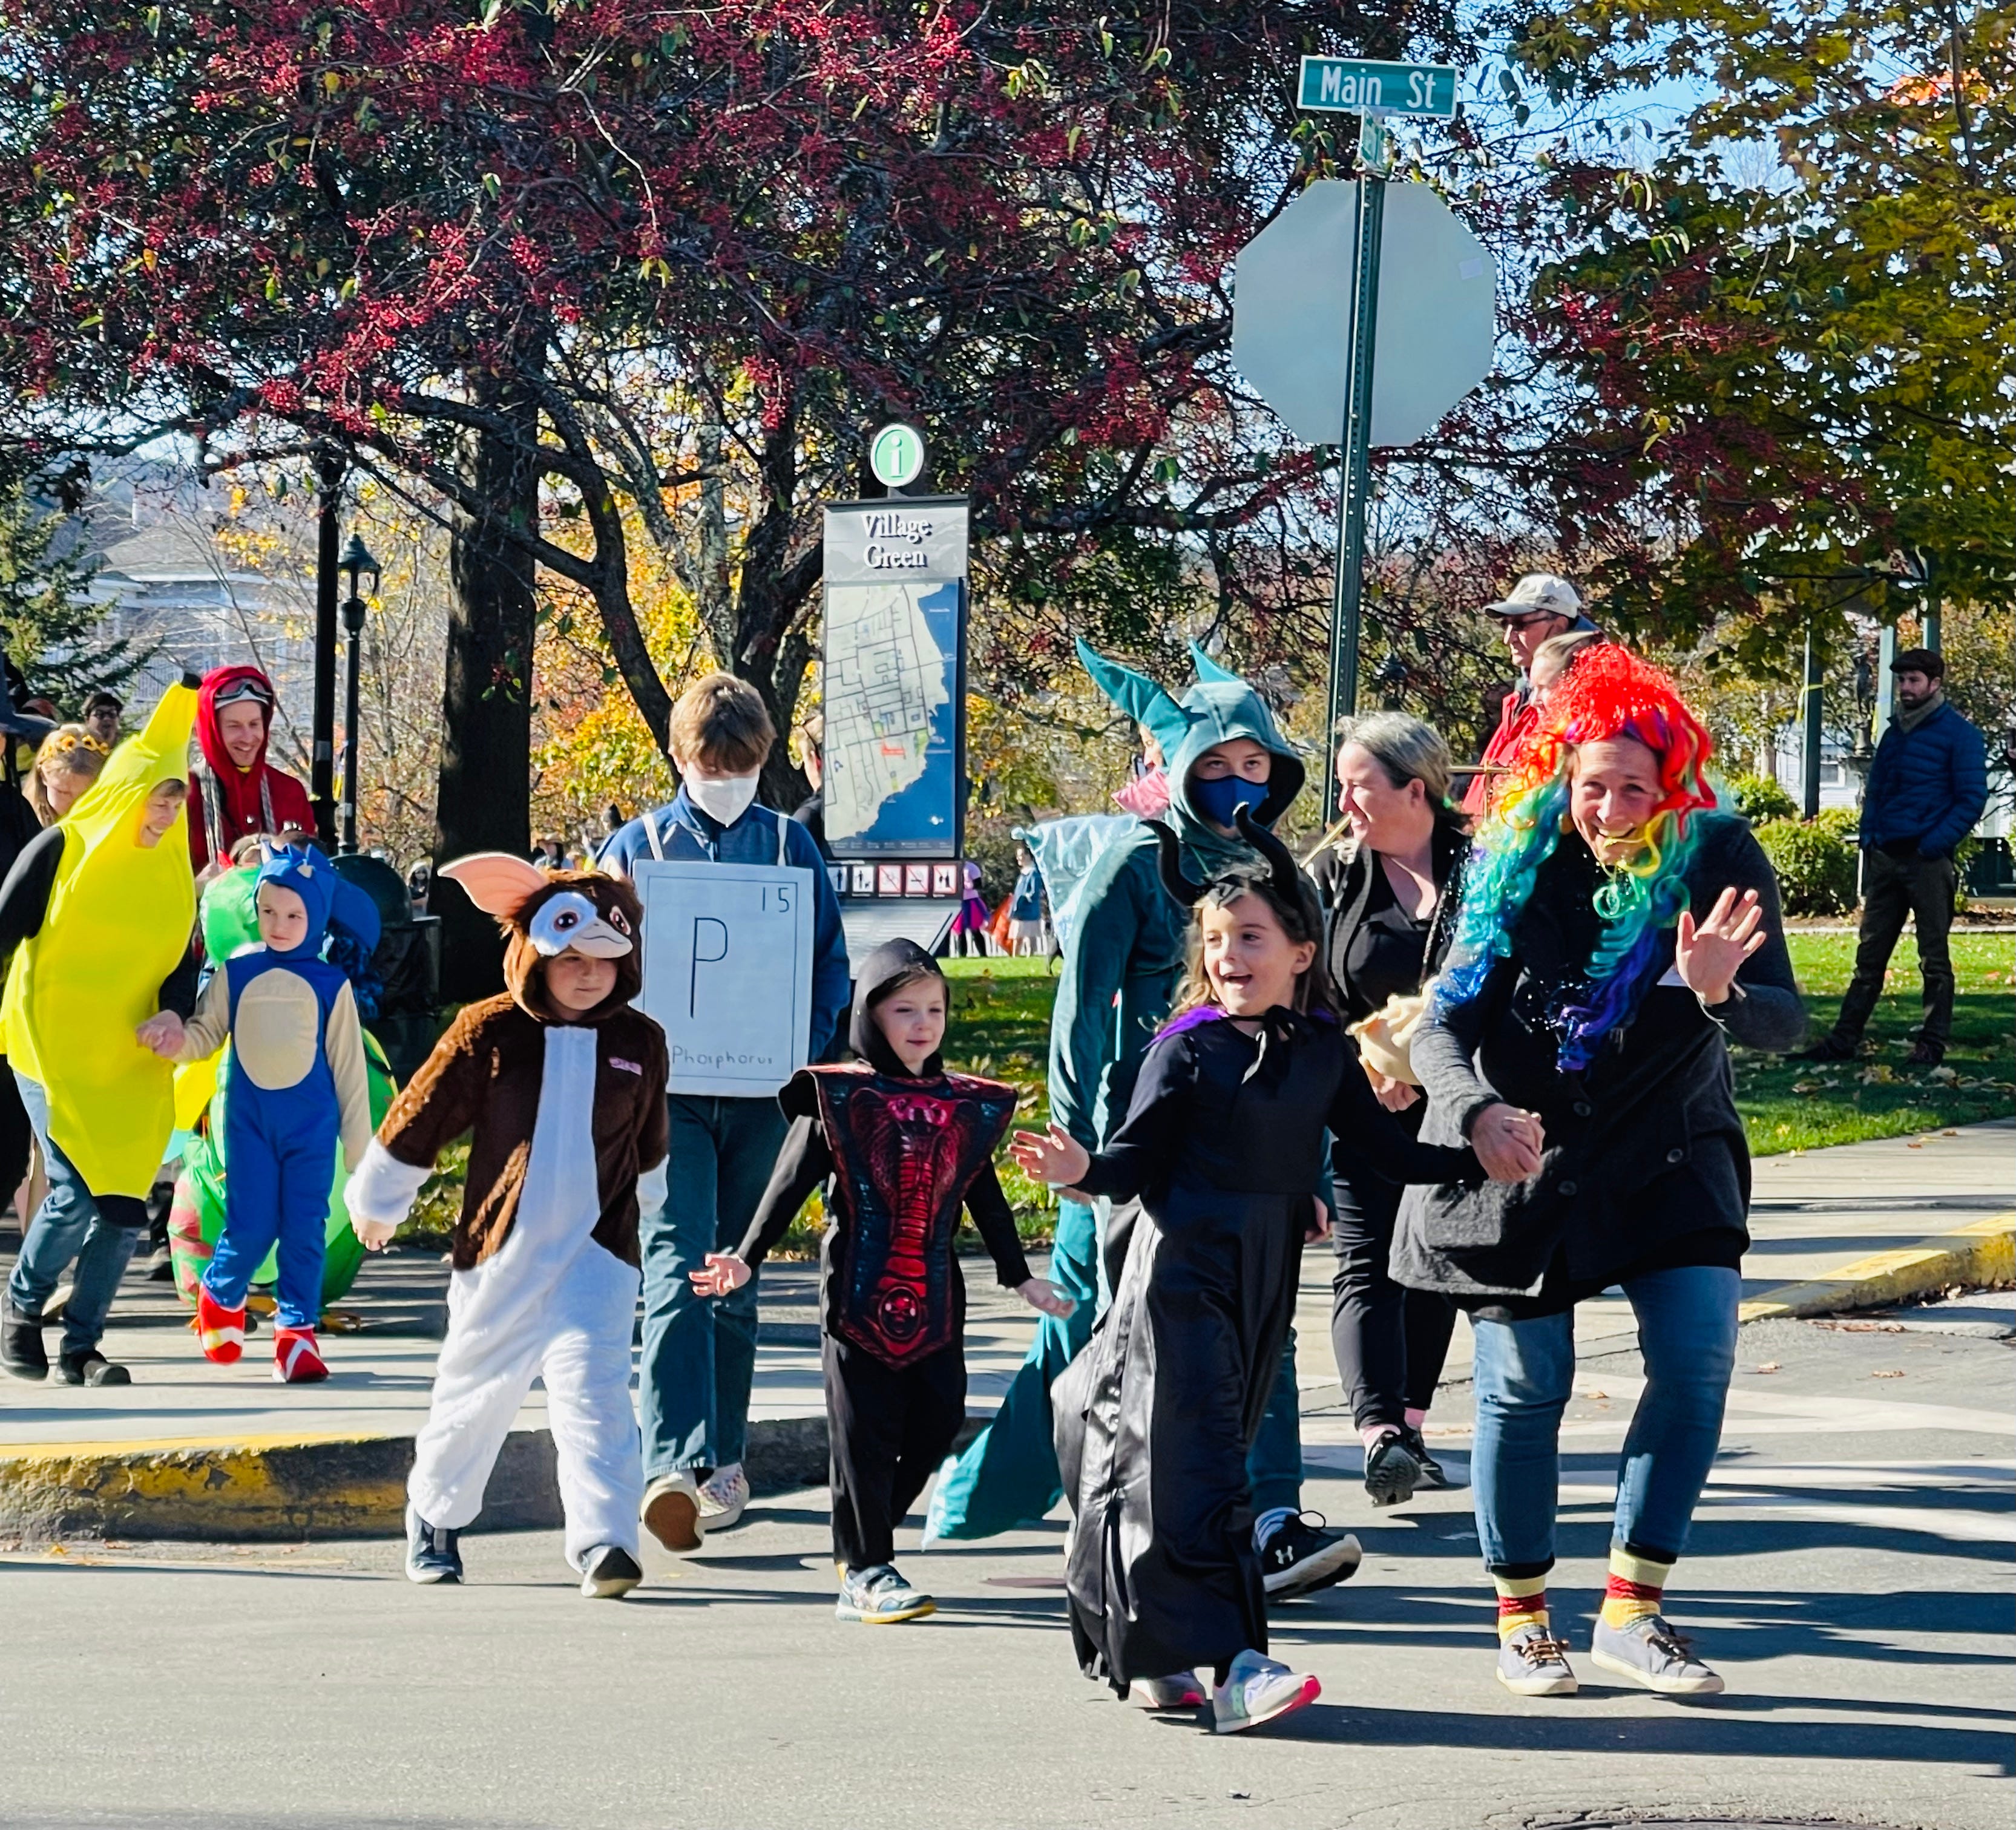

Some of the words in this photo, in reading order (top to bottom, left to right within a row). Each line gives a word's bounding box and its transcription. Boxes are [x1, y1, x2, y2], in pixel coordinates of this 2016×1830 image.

[1320, 65, 1382, 105] Main
[1406, 71, 1437, 109] St
[890, 435, 904, 477] i
[860, 513, 931, 543] Village
[862, 545, 927, 568] Green
[761, 887, 790, 913] 15
[690, 916, 728, 1019] P
[672, 1045, 773, 1069] Phosphorus
